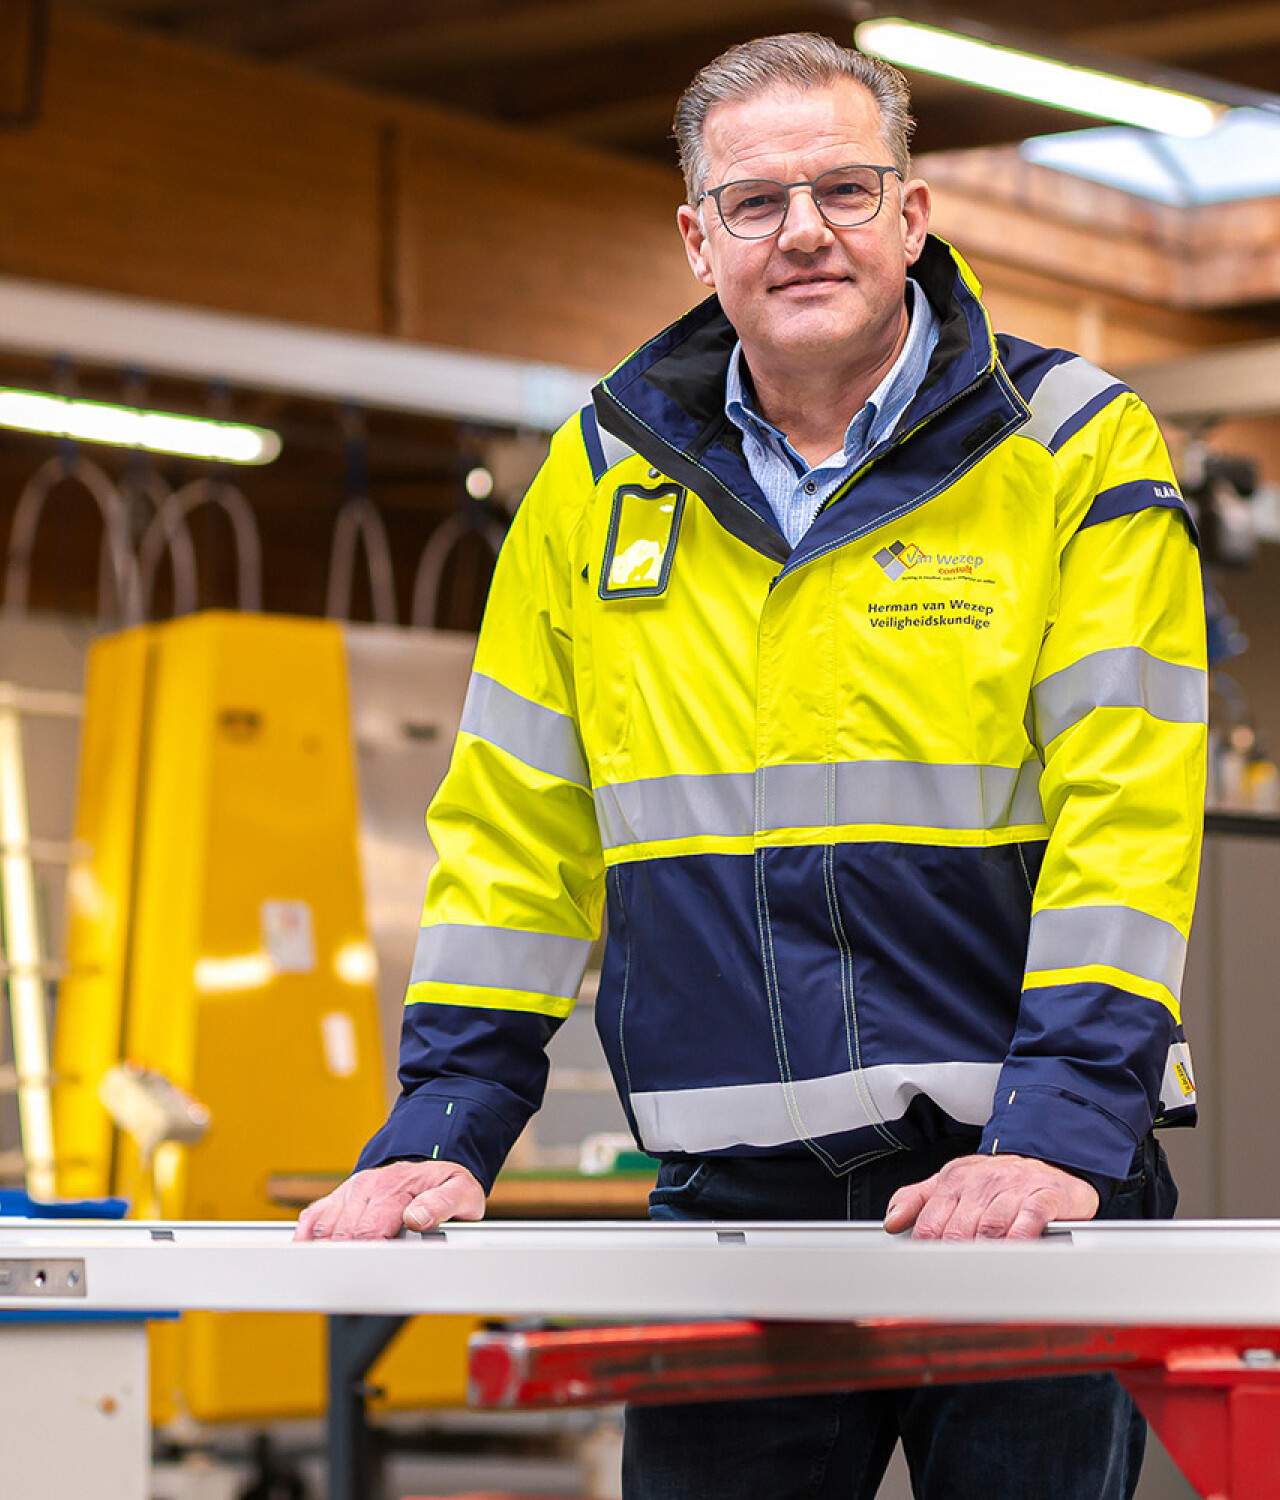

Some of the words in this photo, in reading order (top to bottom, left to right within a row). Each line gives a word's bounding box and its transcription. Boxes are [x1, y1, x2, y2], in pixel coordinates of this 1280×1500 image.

[906, 547, 932, 564] Van
[936, 554, 984, 568] Wezep
[868, 602, 918, 613] Herman
[922, 602, 945, 611] van
[949, 600, 994, 615] Wezep
[870, 615, 990, 630] Veiligheidskundige
